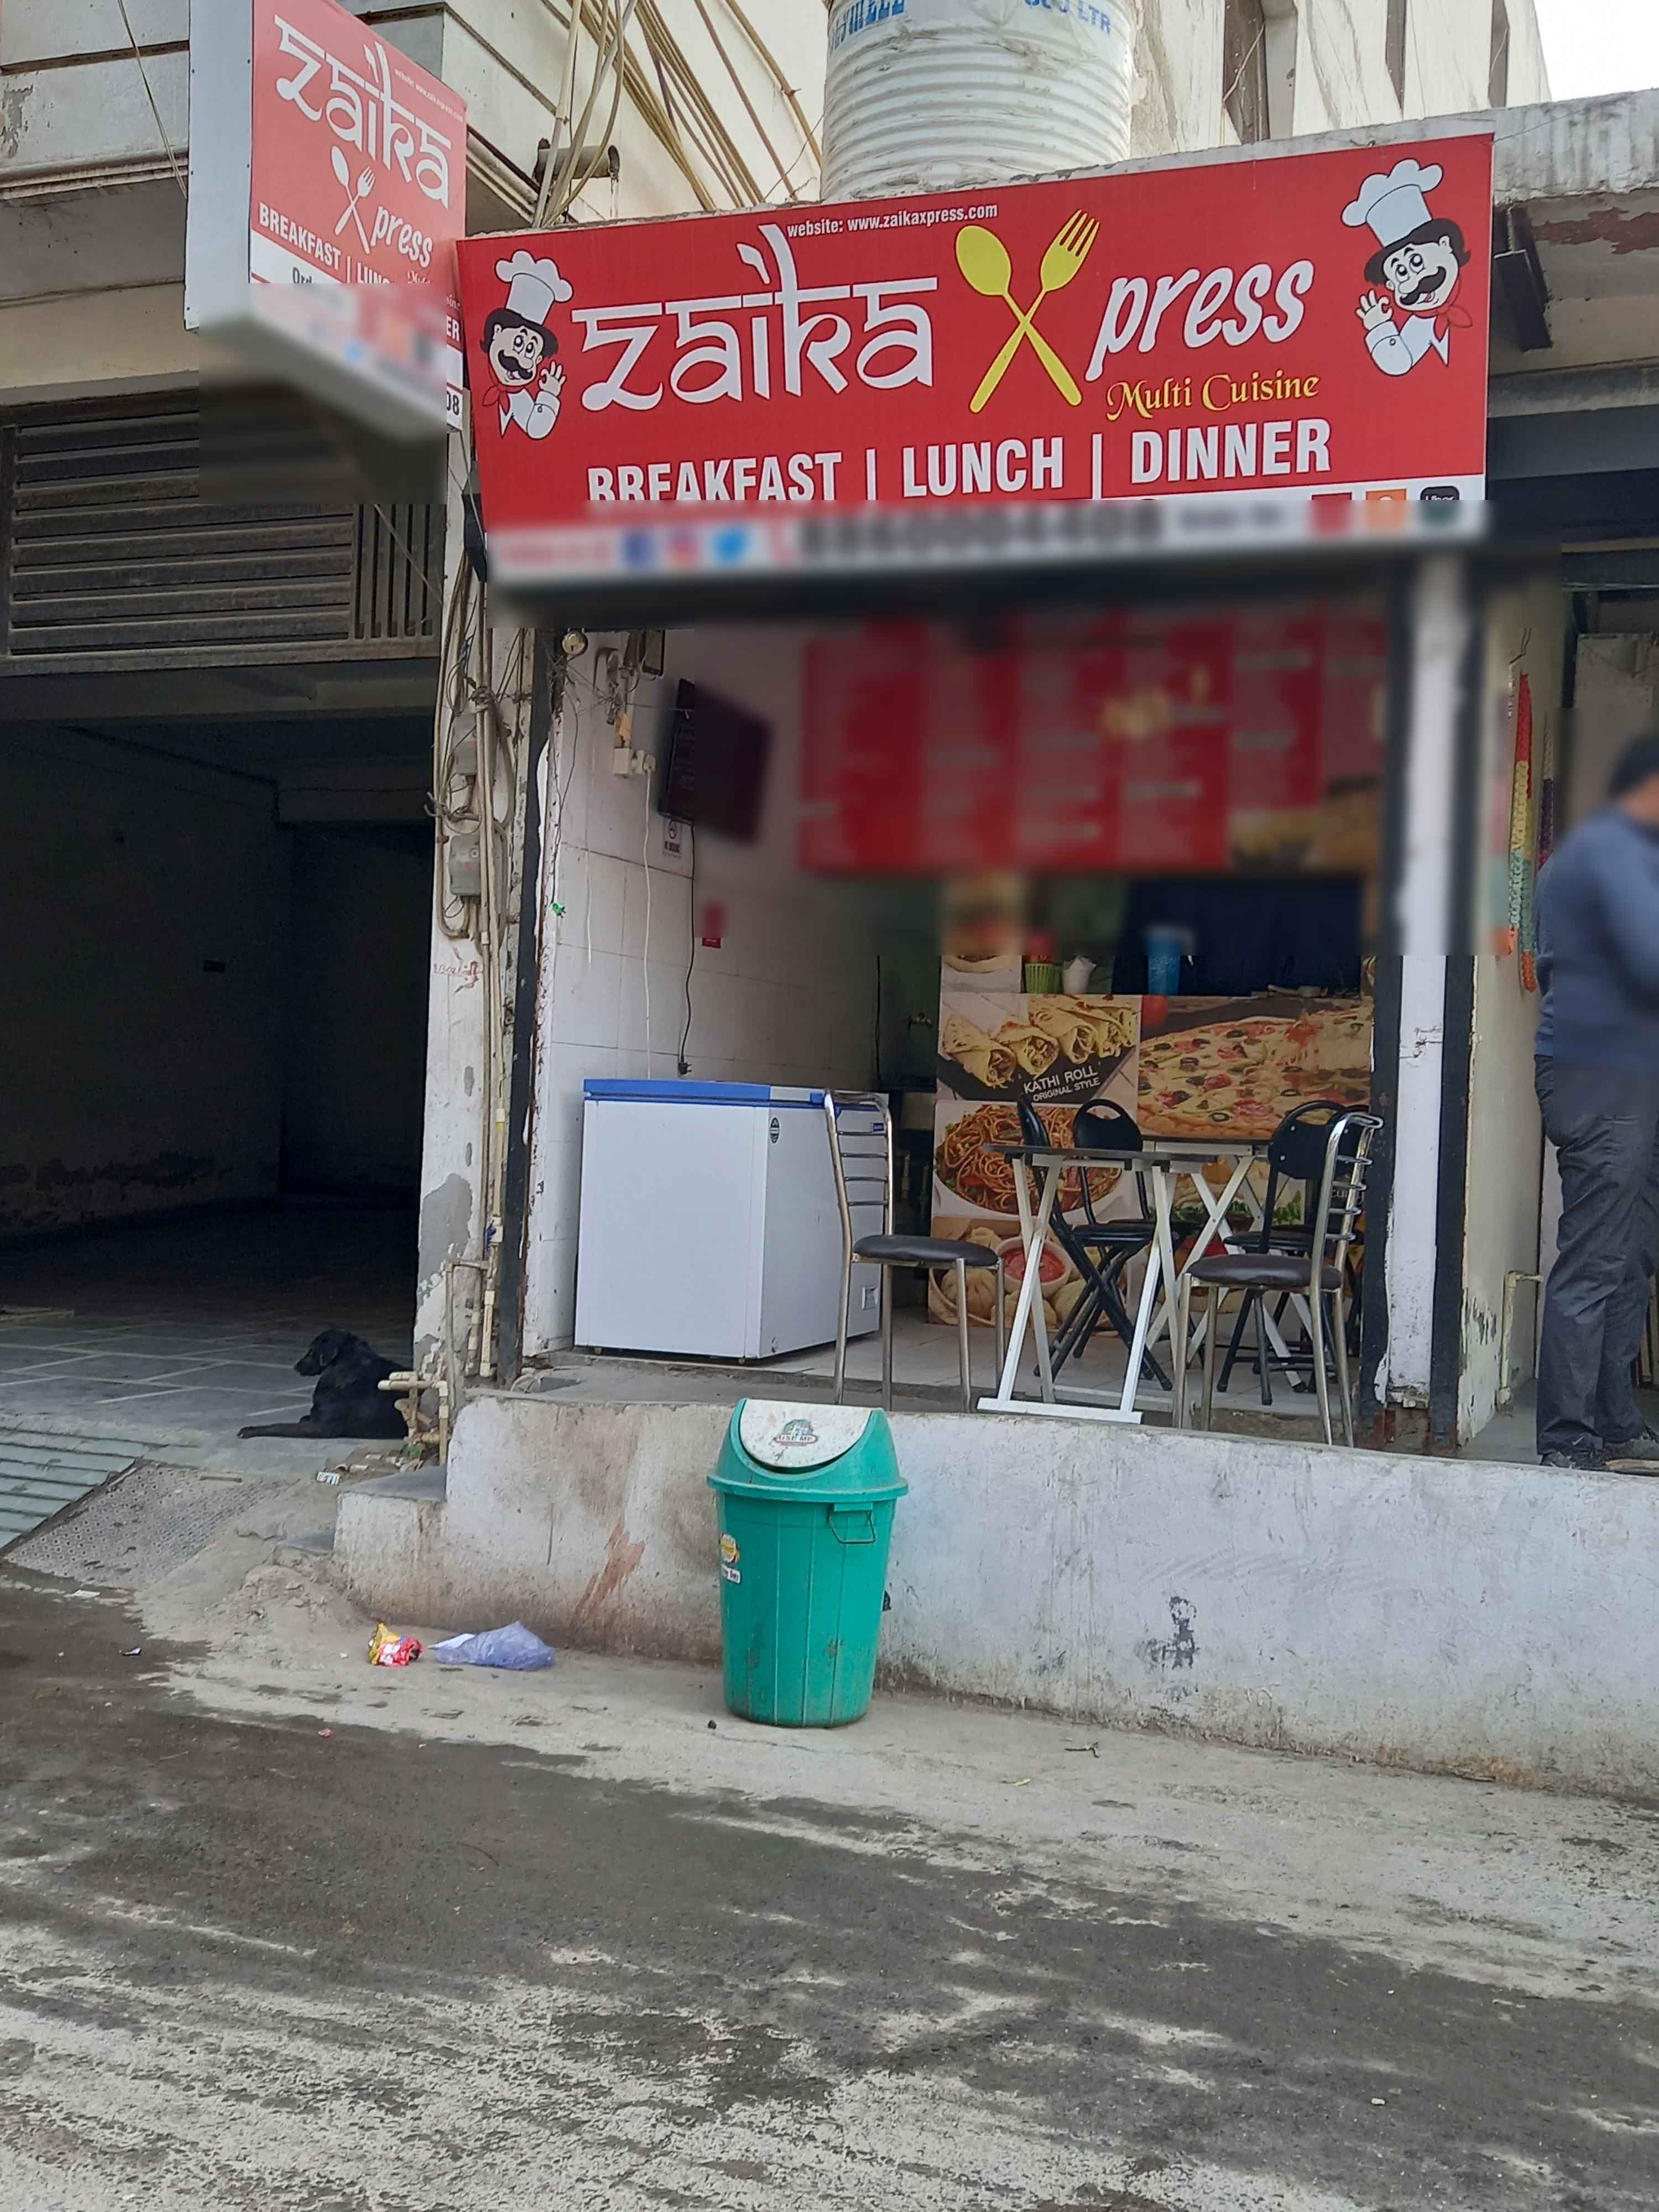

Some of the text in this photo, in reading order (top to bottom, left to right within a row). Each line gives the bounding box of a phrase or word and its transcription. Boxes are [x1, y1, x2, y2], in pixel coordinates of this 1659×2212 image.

[274, 14, 452, 210] zaika
[259, 202, 341, 270] BREAKFAST
[371, 206, 433, 268] press
[787, 203, 998, 238] website: www.zaikaxpress.com
[571, 224, 1315, 412] zaika press
[1106, 369, 1319, 422] Multi Cuisine
[588, 453, 841, 500] BREAKFAST
[902, 435, 1063, 498] LUNCH
[1130, 418, 1331, 484] DINNER
[1024, 1066, 1098, 1094] KATHI ROLL
[1033, 1077, 1100, 1102] ORIGINAL STYLE
